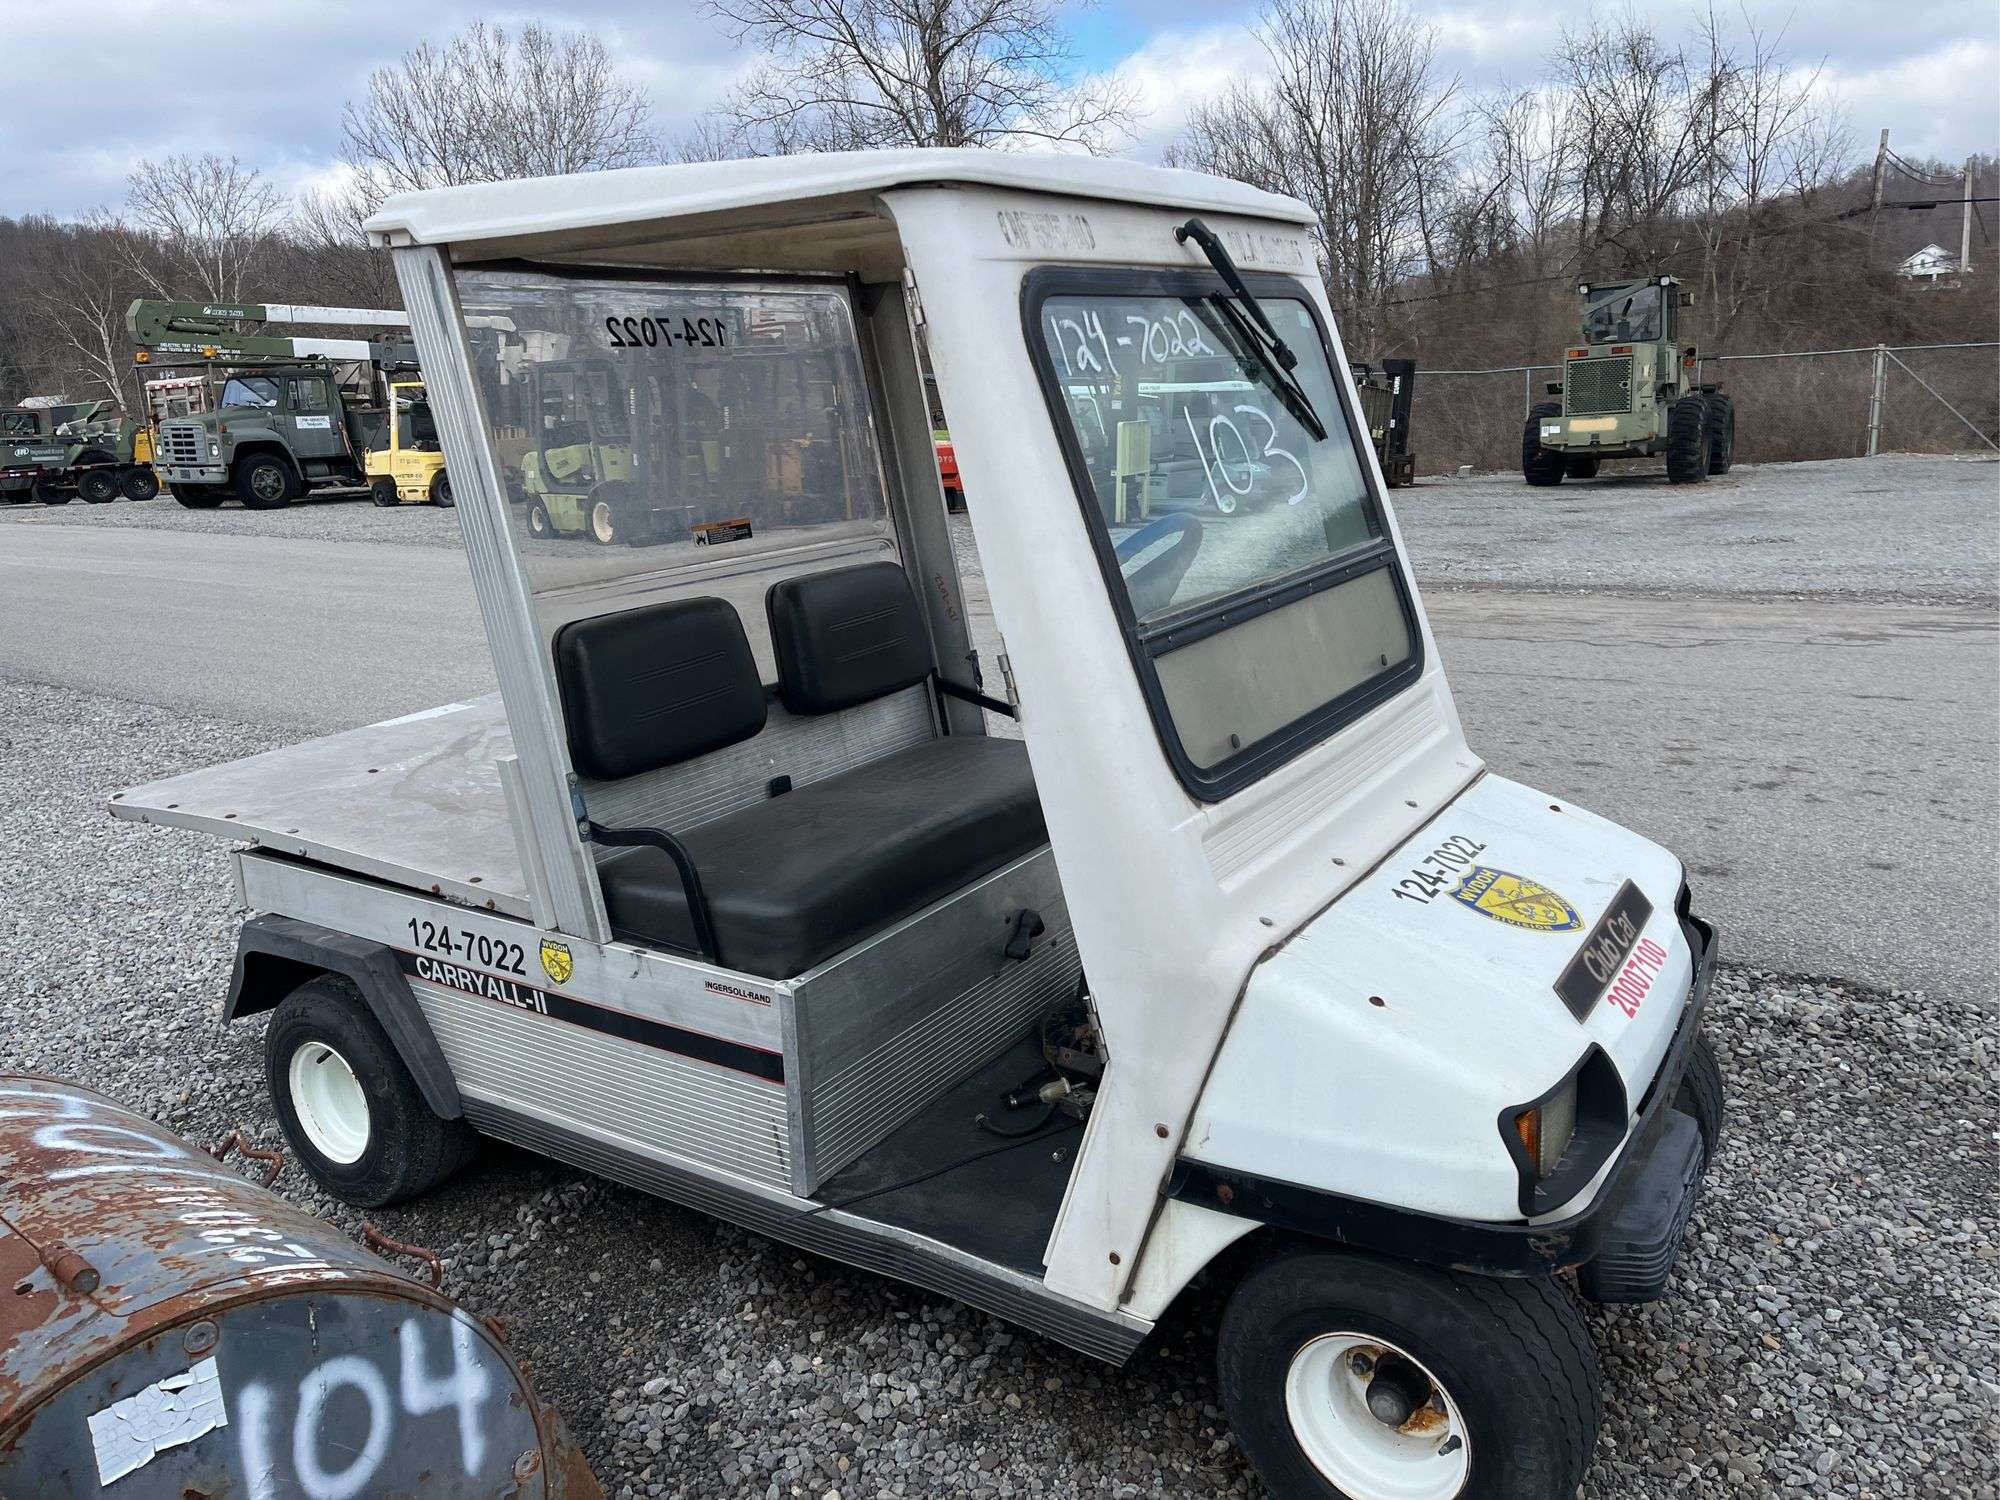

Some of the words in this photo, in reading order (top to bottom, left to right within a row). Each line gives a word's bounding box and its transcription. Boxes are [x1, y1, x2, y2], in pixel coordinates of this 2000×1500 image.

[1051, 310, 1214, 376] 124-7022
[1183, 404, 1308, 514] 103
[1391, 835, 1487, 904] 124-7022
[1456, 868, 1499, 902] WVDOH
[408, 917, 527, 976] 124-7022
[542, 940, 568, 953] WVDOH
[1583, 934, 1622, 983] Club
[1605, 909, 1638, 949] Car
[1607, 937, 1668, 1019] 20007100
[416, 956, 548, 1015] CARRYALL-II
[704, 980, 772, 1004] INGERSOLL-RAND
[238, 1306, 492, 1500] 104
